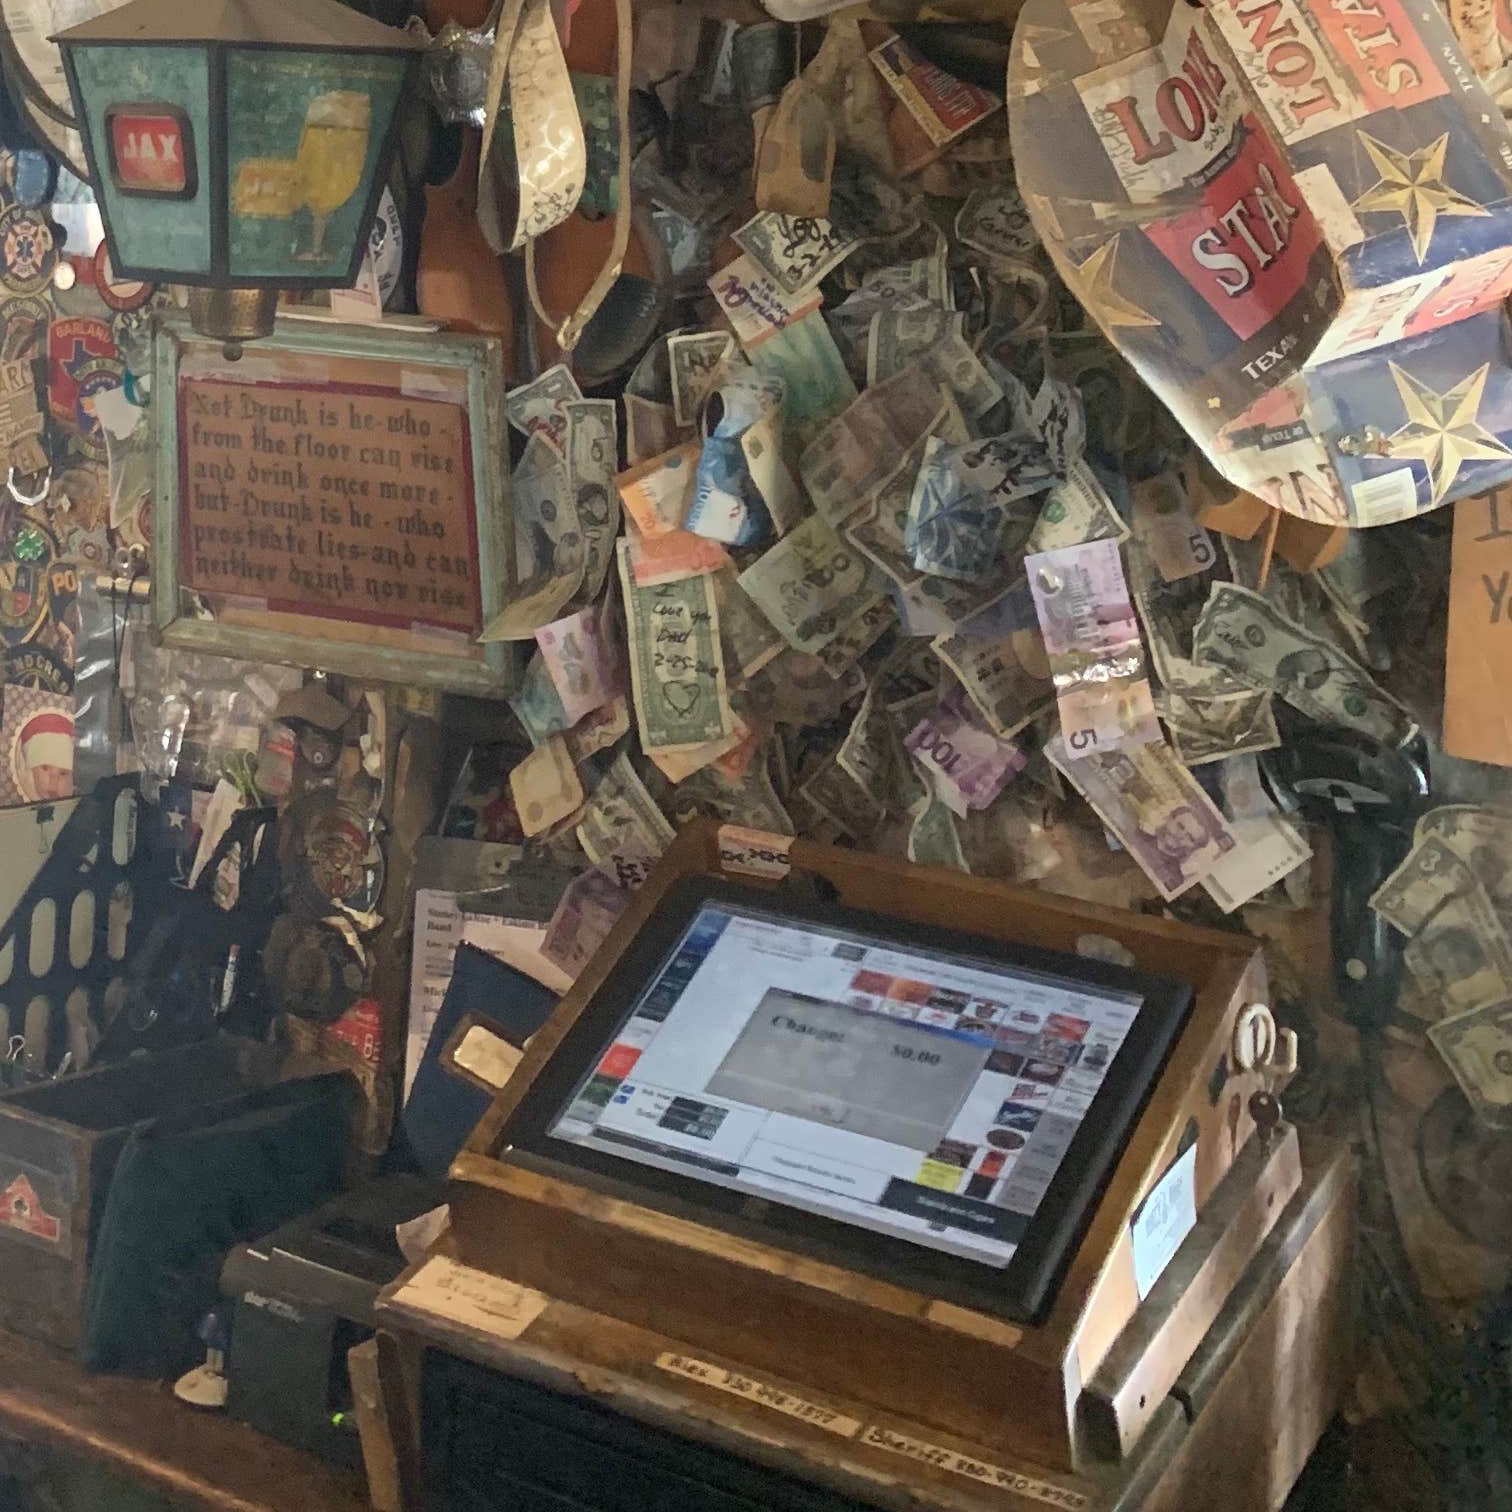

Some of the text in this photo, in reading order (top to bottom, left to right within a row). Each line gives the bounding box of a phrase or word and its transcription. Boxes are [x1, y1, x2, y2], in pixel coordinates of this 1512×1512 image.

[122, 132, 178, 163] JAX
[240, 392, 309, 426] Drunk
[319, 401, 338, 427] is
[349, 402, 374, 430] he
[387, 408, 431, 437] who
[191, 422, 242, 450] from
[252, 422, 286, 455] the
[294, 433, 351, 462] floor
[359, 446, 401, 473] can
[194, 456, 236, 485] and
[247, 458, 310, 493] drink
[194, 483, 231, 512] but
[242, 489, 313, 525] Drunk
[320, 496, 342, 525] is
[349, 498, 374, 529] he
[195, 550, 278, 582] neither
